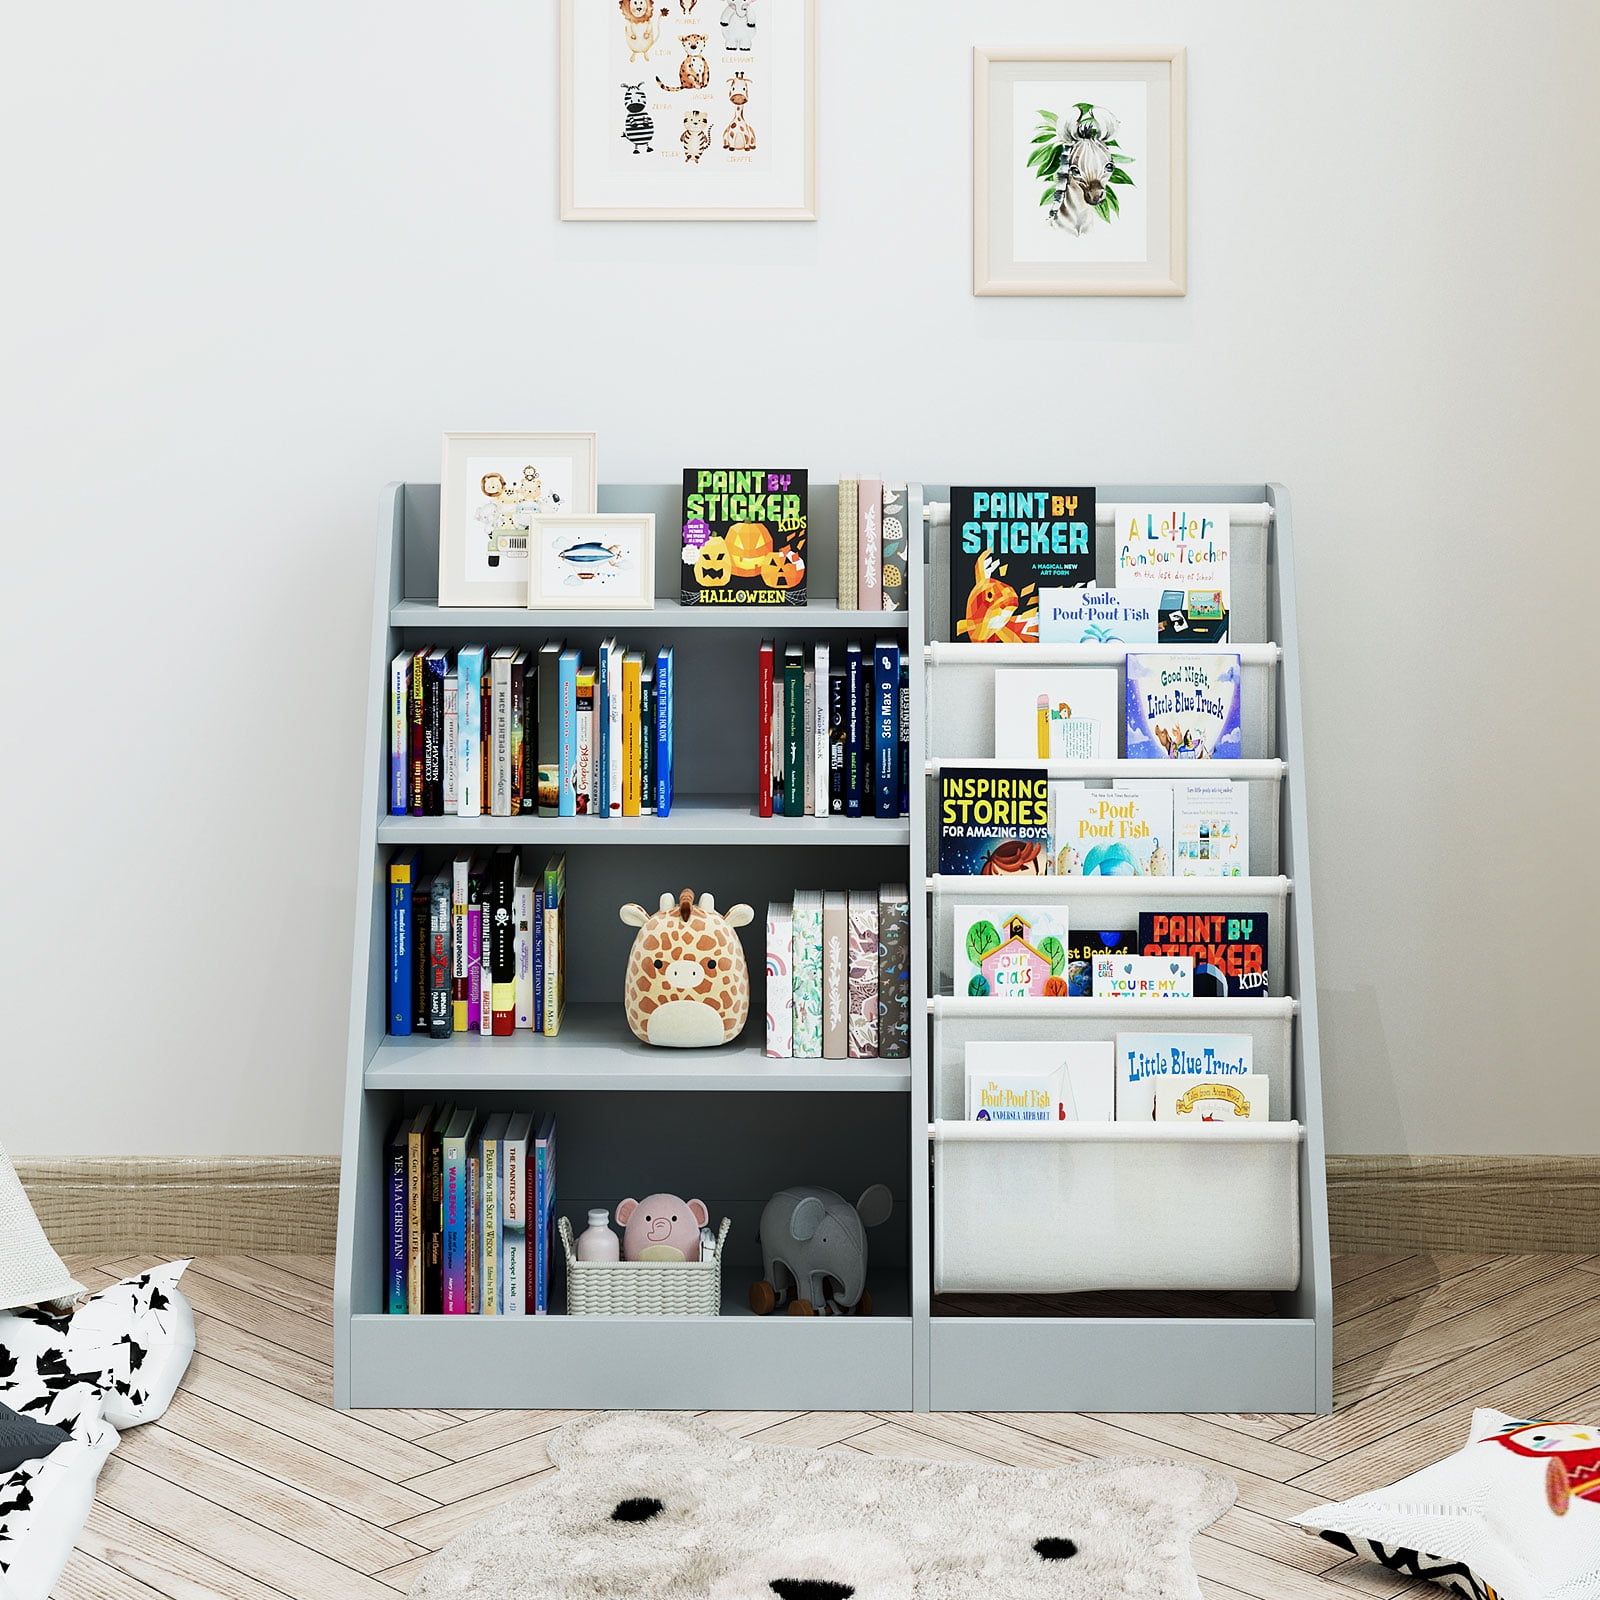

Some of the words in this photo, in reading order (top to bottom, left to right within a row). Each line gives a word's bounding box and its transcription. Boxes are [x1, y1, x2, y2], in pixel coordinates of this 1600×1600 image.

[698, 471, 765, 493] PAINT
[768, 474, 791, 491] BY
[687, 494, 800, 521] STICKER
[973, 492, 1049, 519] PAINT
[1051, 496, 1078, 516] BY
[778, 515, 807, 532] KIDS
[1128, 518, 1140, 541] A
[1147, 511, 1213, 541] Letter
[962, 521, 1089, 554] STICKER
[1120, 545, 1147, 569] from
[1176, 542, 1228, 564] Teacher
[700, 590, 786, 603] HALLOWEEN
[1082, 592, 1120, 606] Smile,
[1053, 607, 1120, 621] Pout-Pout
[1124, 607, 1150, 621] Fish
[414, 657, 422, 697] МИЛОСЕРДИЯ
[881, 682, 891, 690] 9
[1160, 668, 1182, 687] Good
[414, 699, 422, 725] Диета
[833, 680, 841, 726] HALO
[881, 693, 891, 716] Max
[1147, 693, 1173, 719] Little
[1174, 690, 1195, 712] Blue
[1195, 690, 1224, 719] Truck
[881, 719, 891, 738] 3ds
[943, 778, 1047, 798] INSPIRING
[943, 800, 1047, 824] STORIES
[1098, 801, 1140, 820] Pout-
[943, 826, 963, 837] FOR
[966, 827, 1016, 838] AMAZING
[1019, 827, 1047, 838] BOYS
[1079, 820, 1114, 839] Pout
[1119, 820, 1150, 839] Fish
[1153, 916, 1225, 943] PAINT
[1227, 919, 1253, 940] BY
[1111, 980, 1155, 990] YOU'RE
[1159, 980, 1176, 990] MY
[1239, 971, 1268, 990] KIDS
[1128, 1051, 1167, 1081] Little
[1171, 1048, 1201, 1074] Blue
[988, 1082, 998, 1091] The
[981, 1089, 1028, 1107] Pout-Pout
[1031, 1089, 1051, 1107] Fish
[394, 1156, 404, 1176] YES,
[486, 1150, 495, 1171] PEARLS
[394, 1178, 404, 1193] I'M
[486, 1173, 495, 1189] FROM
[486, 1191, 495, 1202] THE
[412, 1214, 419, 1226] AT
[486, 1204, 495, 1219] SEAT
[394, 1203, 404, 1260] CHRISTIAN!
[486, 1230, 495, 1256] WISDOM
[509, 1247, 517, 1275] Penelope
[509, 1283, 517, 1297] Holt
